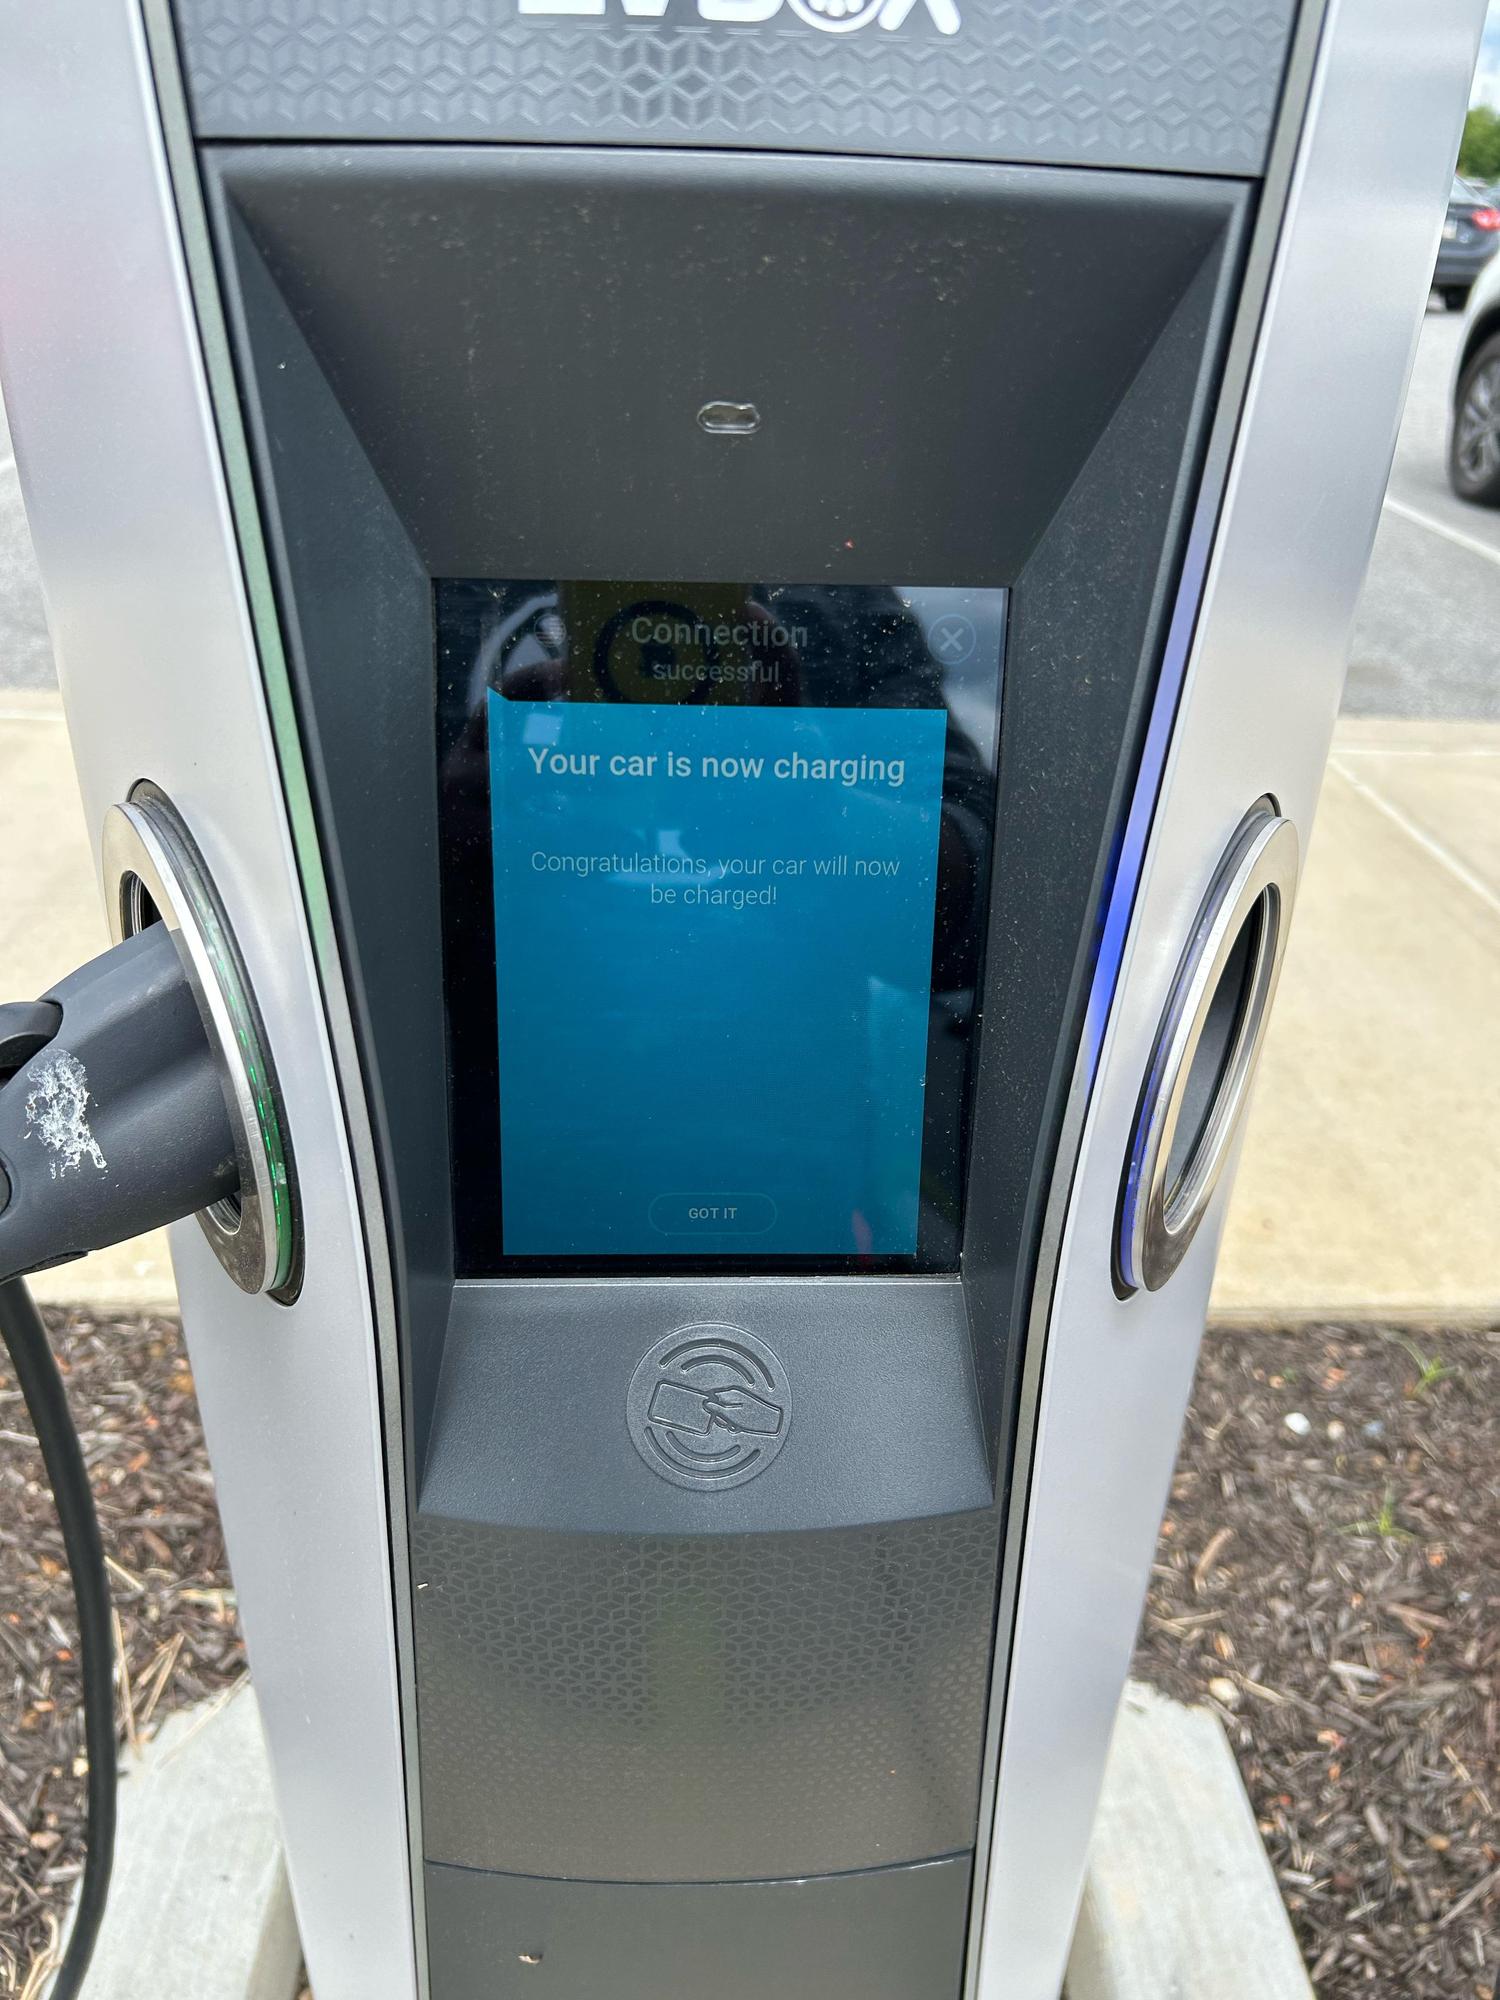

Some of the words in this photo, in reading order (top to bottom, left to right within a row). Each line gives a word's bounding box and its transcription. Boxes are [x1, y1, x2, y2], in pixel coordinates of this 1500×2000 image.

[631, 616, 808, 648] Connection
[652, 659, 780, 683] successful
[528, 747, 600, 776] Your
[609, 754, 658, 777] car
[667, 751, 692, 778] is
[702, 756, 765, 779] now
[774, 752, 905, 788] charging
[531, 851, 712, 878] Congratulations,
[718, 858, 767, 880] your
[772, 859, 808, 876] car
[813, 855, 848, 876] will
[855, 859, 900, 877] now
[651, 883, 677, 905] be
[683, 883, 777, 910] charged!
[688, 1207, 720, 1220] GOT
[723, 1207, 738, 1220] IT
